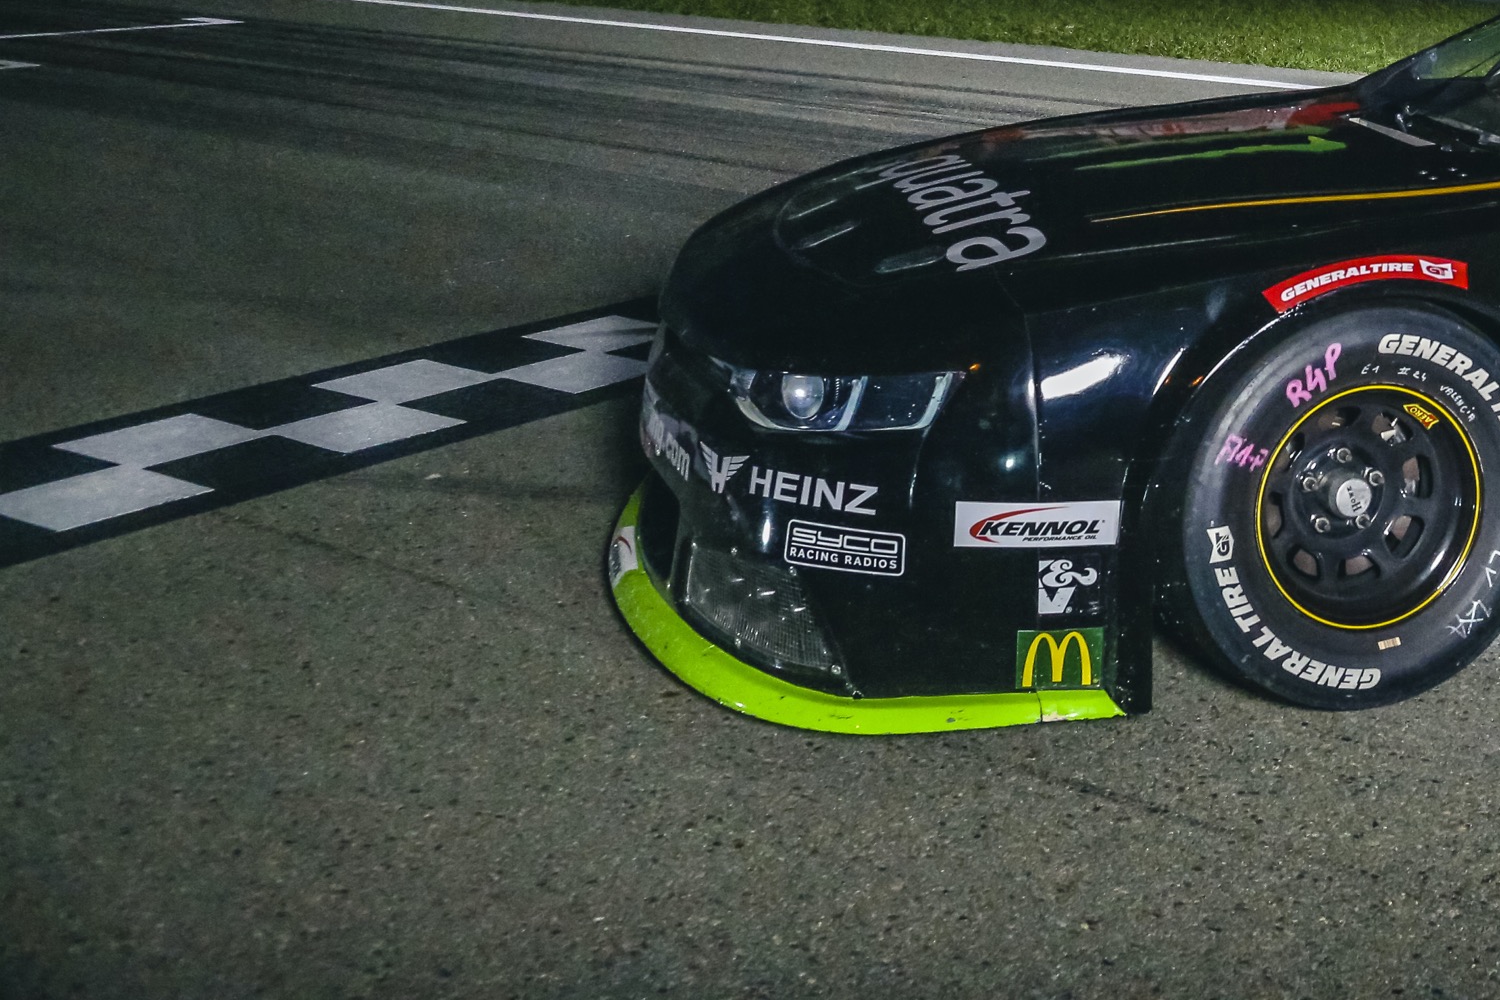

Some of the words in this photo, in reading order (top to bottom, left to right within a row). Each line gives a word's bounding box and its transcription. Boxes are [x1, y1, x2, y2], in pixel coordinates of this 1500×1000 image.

[879, 154, 1047, 272] quatra
[1378, 334, 1500, 401] GENERAL
[749, 466, 879, 516] HEINZ
[792, 527, 898, 554] SYCO
[979, 520, 1100, 536] KENNOL
[790, 547, 838, 563] RACING
[844, 554, 898, 570] RADIOS
[1214, 566, 1261, 633] TIRE
[1252, 626, 1381, 690] GENERAL
